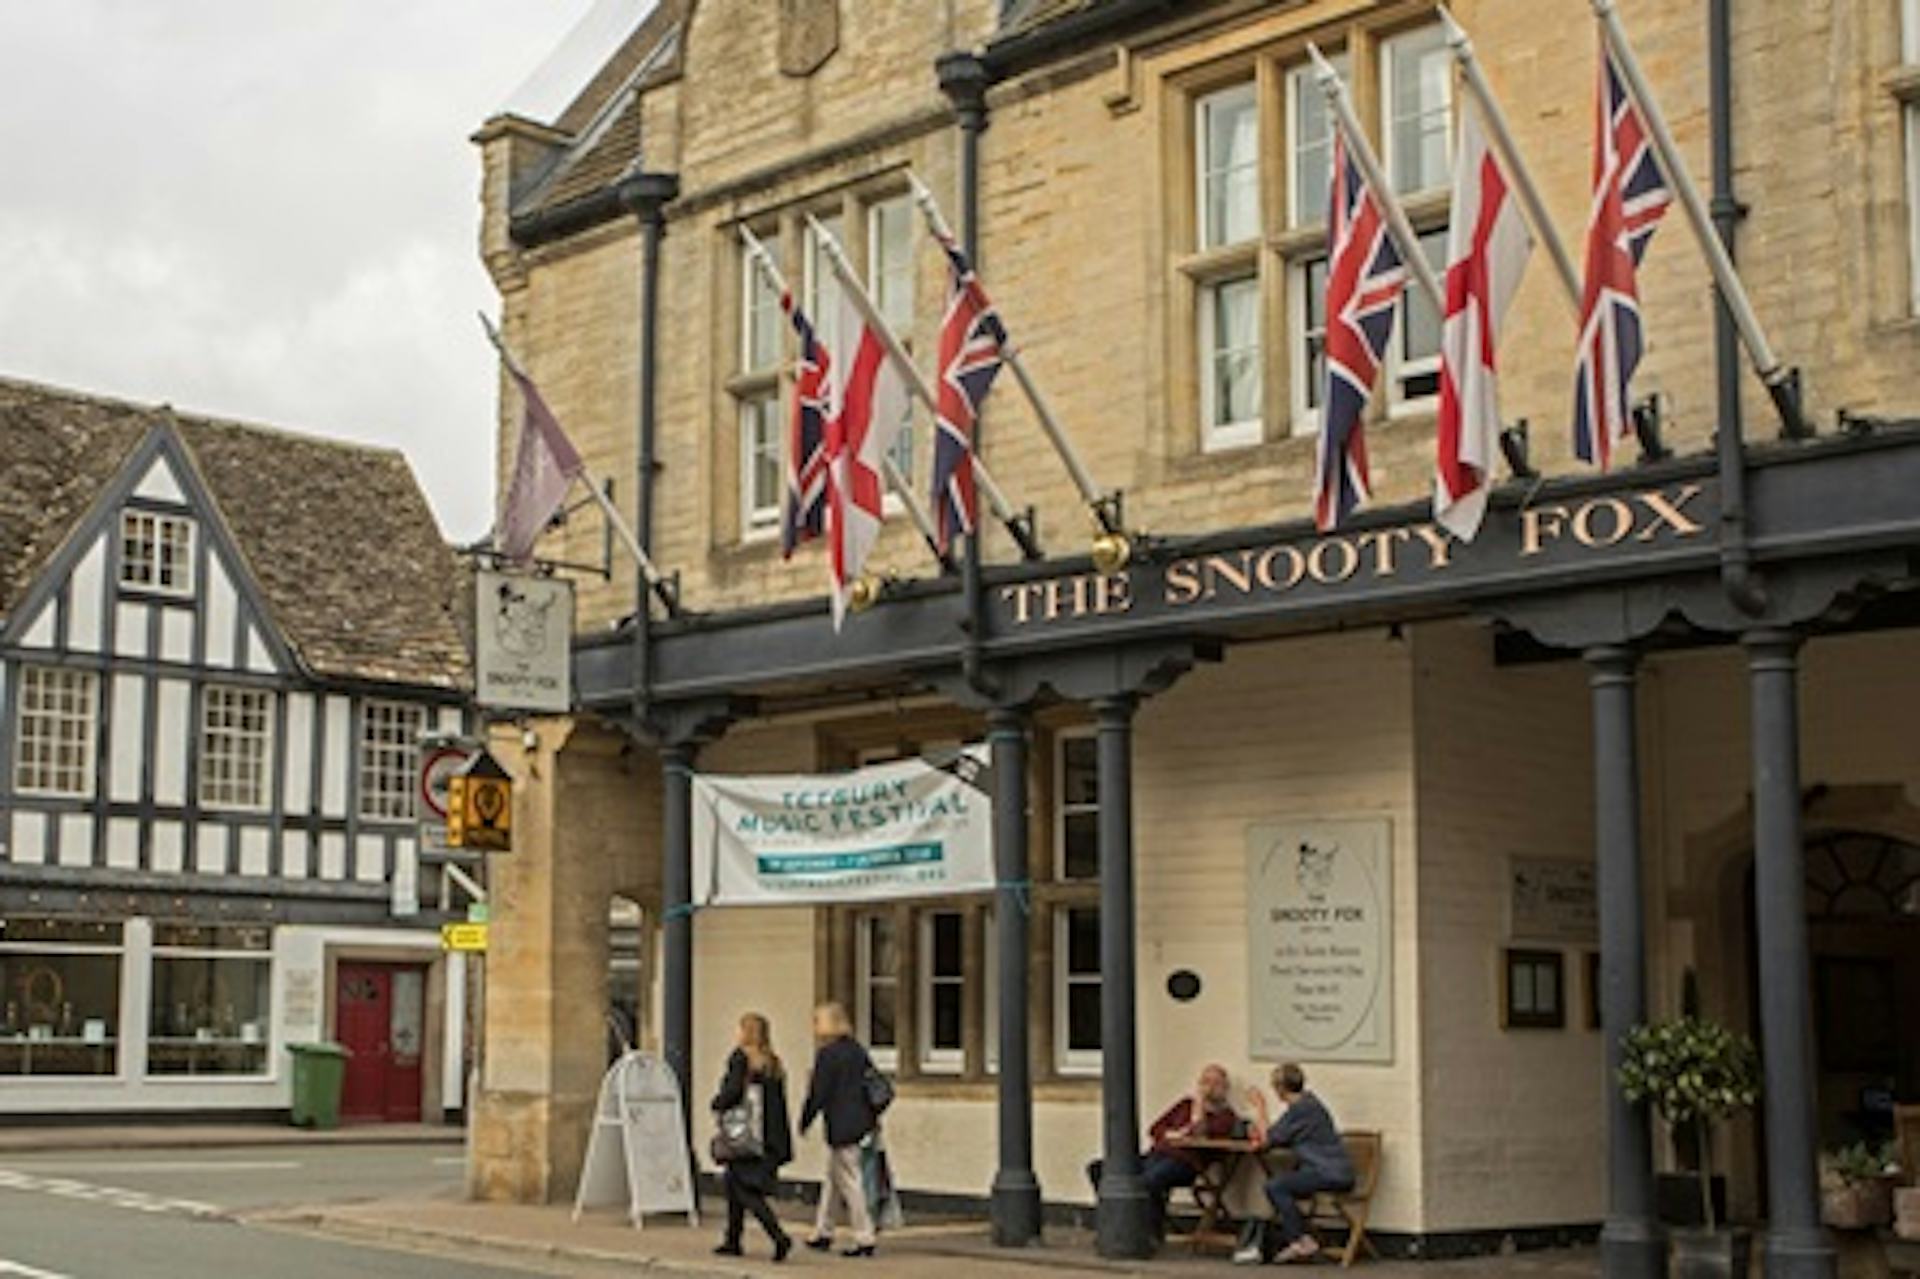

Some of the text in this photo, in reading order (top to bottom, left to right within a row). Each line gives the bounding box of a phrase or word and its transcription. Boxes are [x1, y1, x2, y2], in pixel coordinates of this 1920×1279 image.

[1001, 484, 1704, 623] THE SNOOTY FOX
[735, 791, 969, 834] MUSIC FESTIVAL
[1270, 907, 1364, 923] SNOOTY FOX
